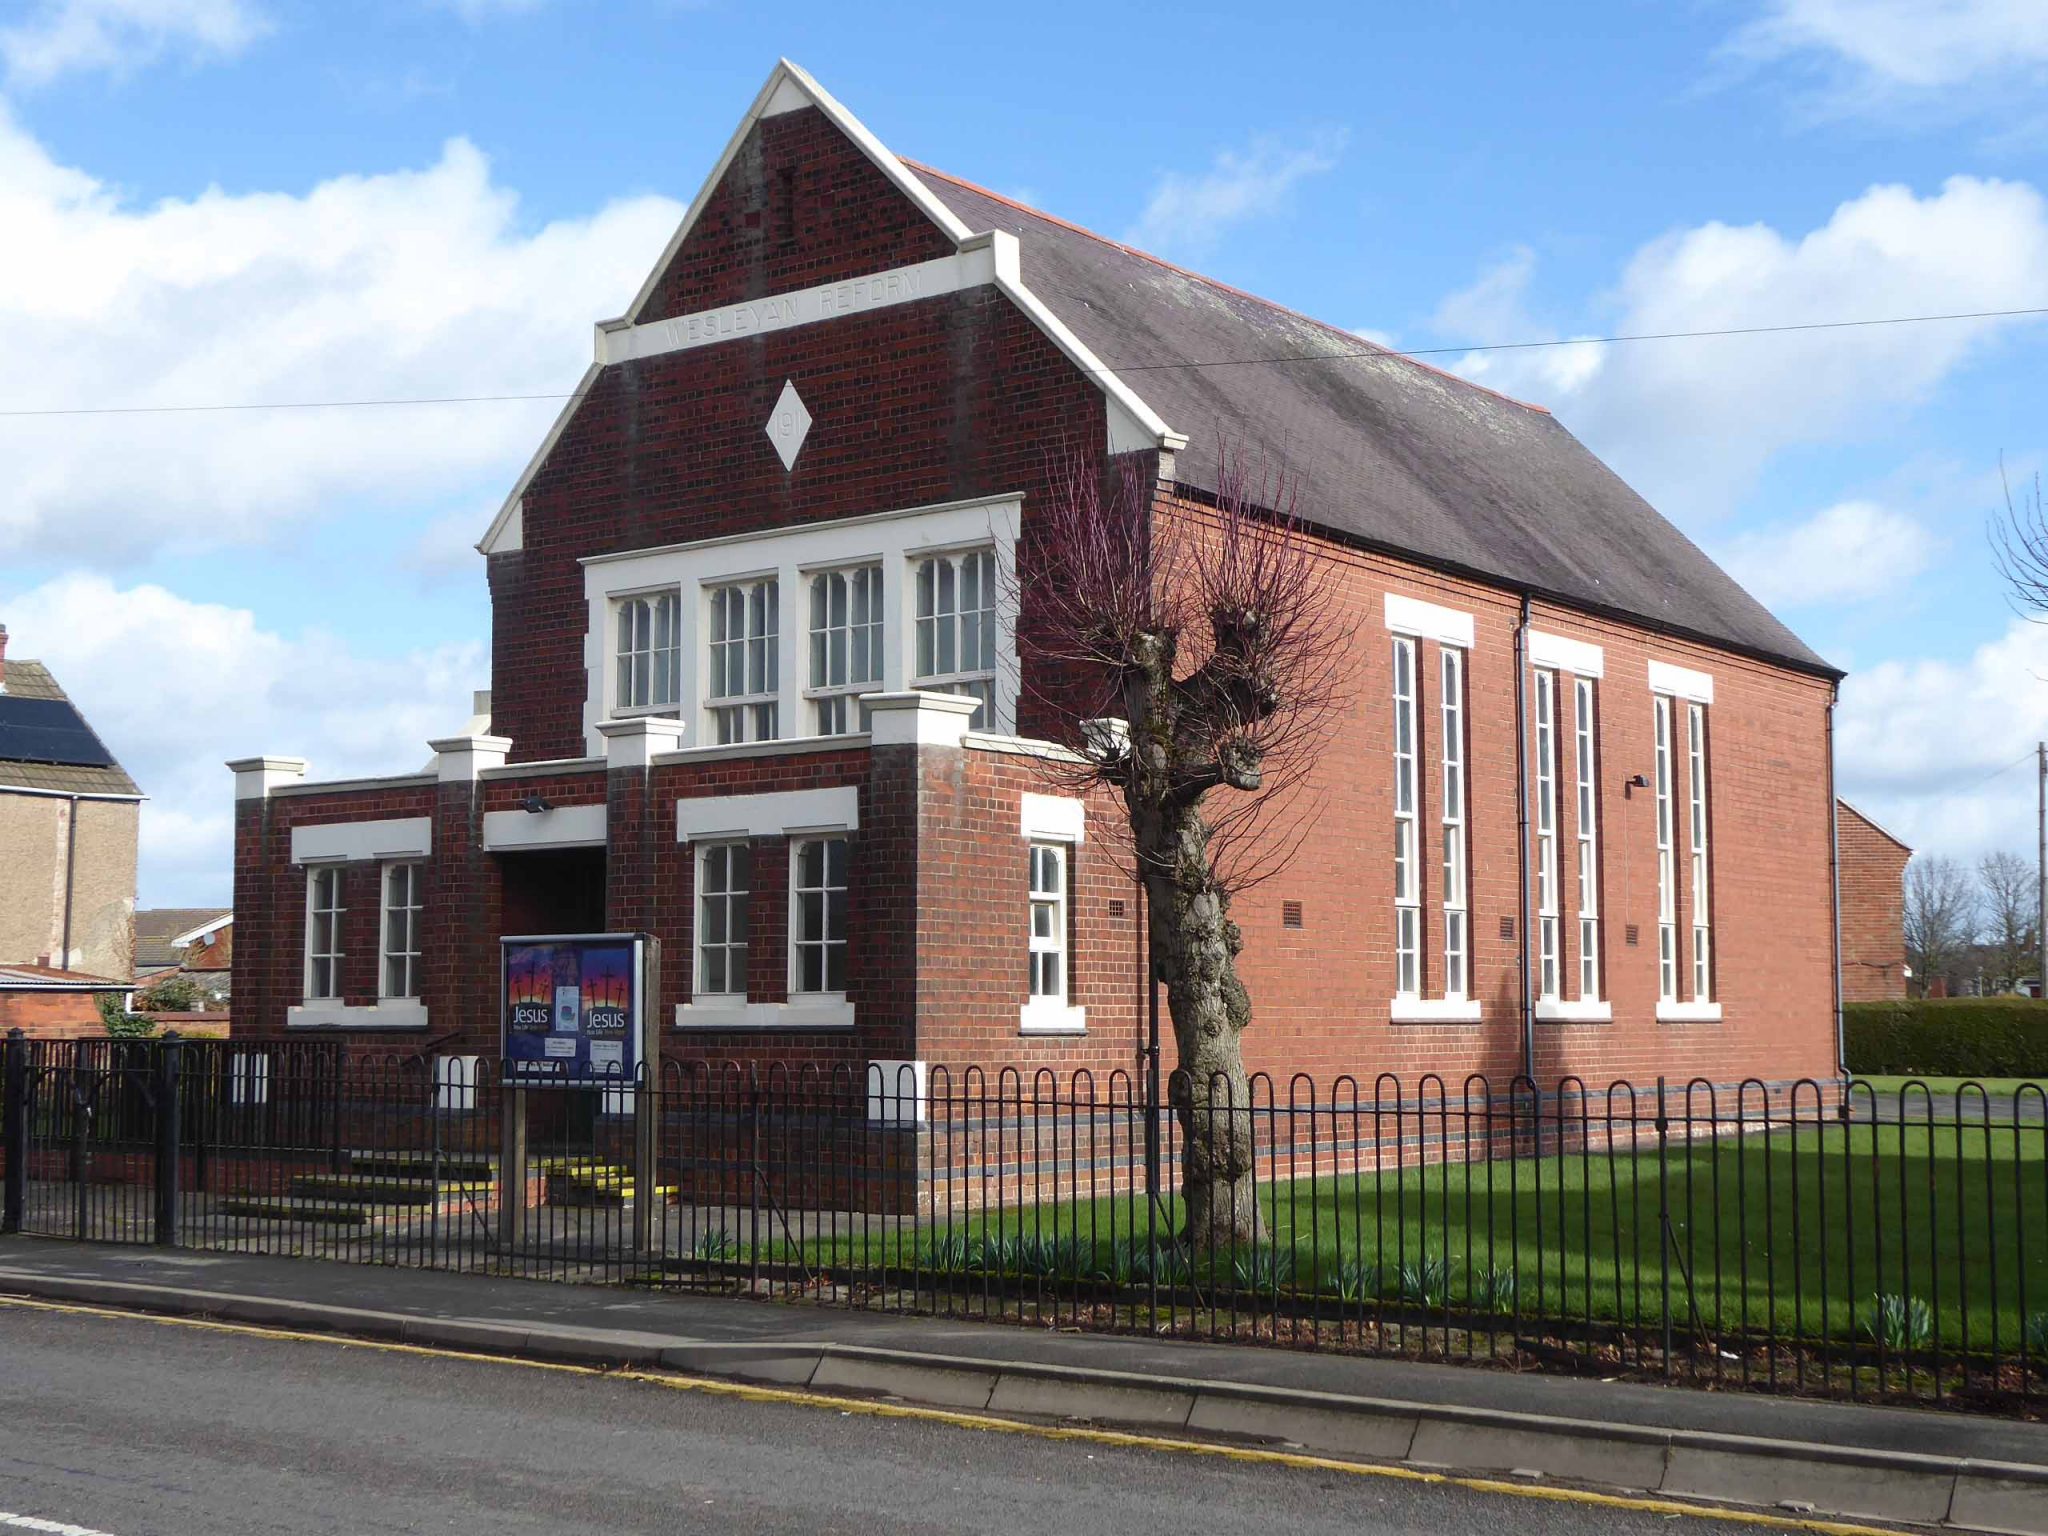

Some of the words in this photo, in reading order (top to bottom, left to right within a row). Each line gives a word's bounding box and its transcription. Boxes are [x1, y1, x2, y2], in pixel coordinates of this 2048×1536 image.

[666, 297, 797, 345] WESLEYAN
[819, 270, 921, 313] REFORM
[775, 409, 802, 439] 1911
[513, 1006, 548, 1023] Jesus
[587, 1010, 625, 1028] Jesus
